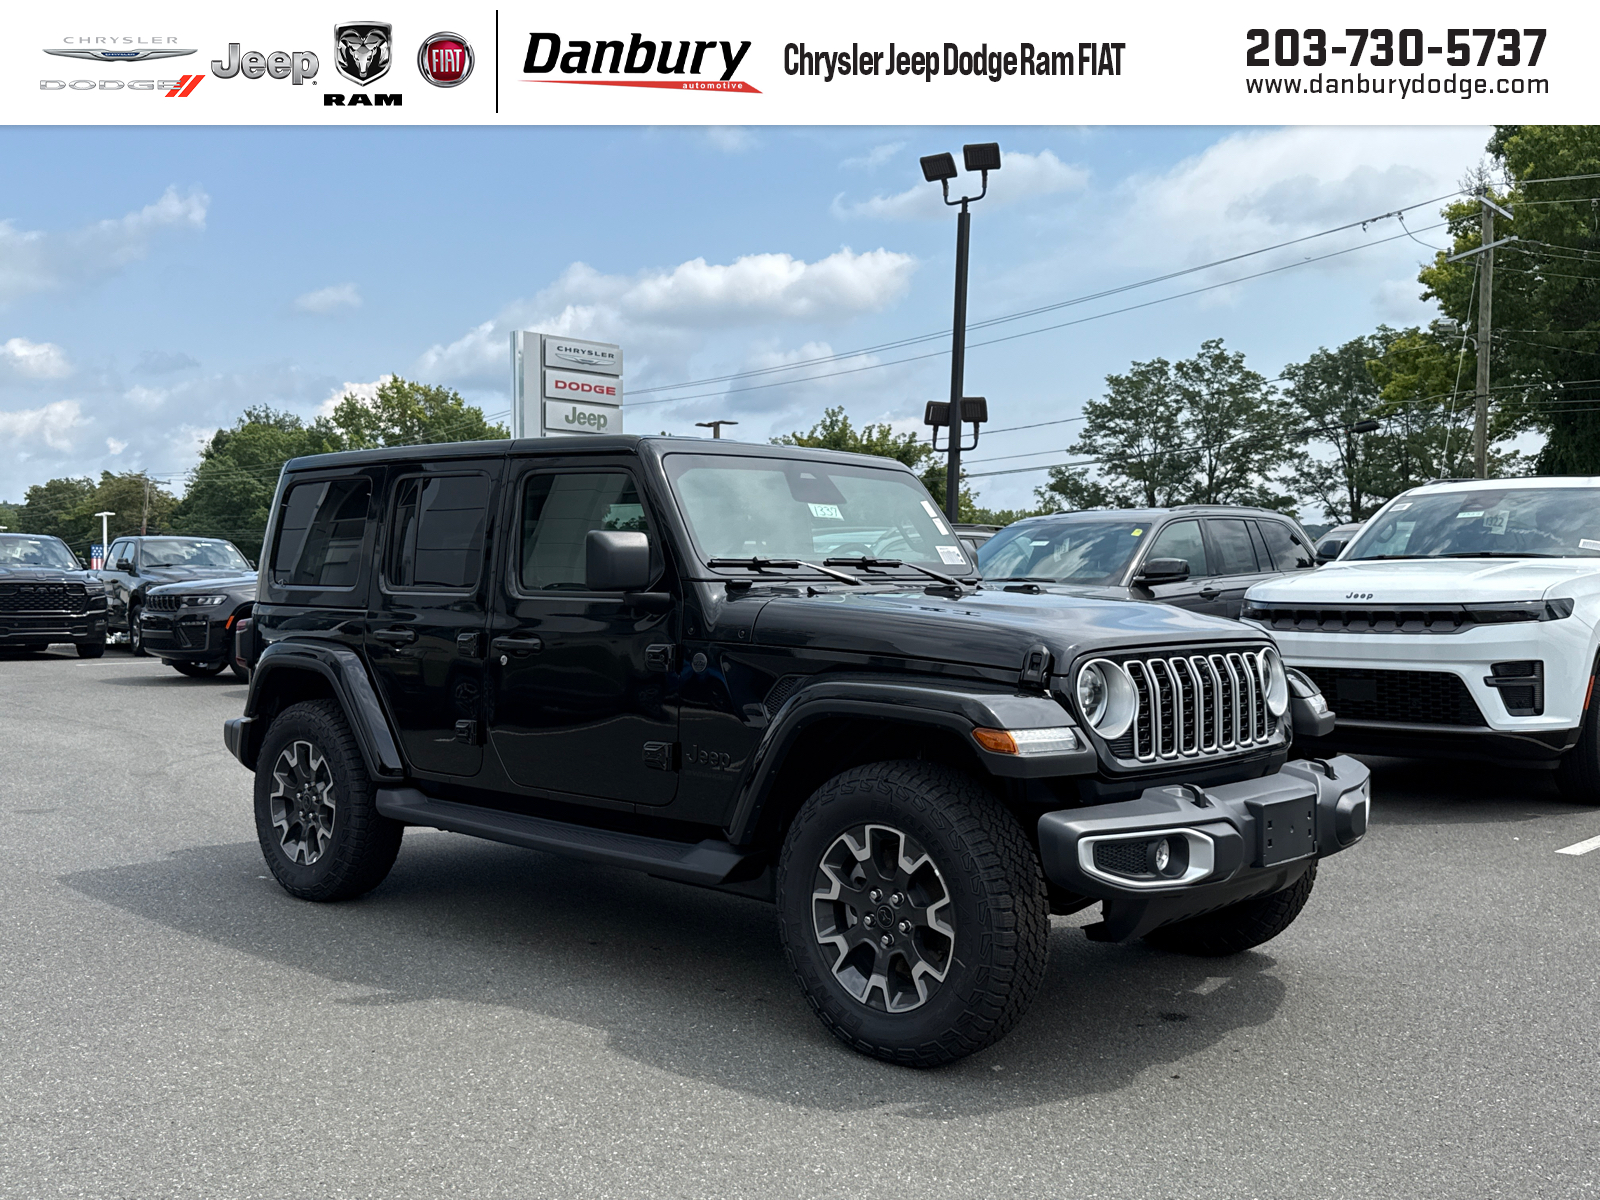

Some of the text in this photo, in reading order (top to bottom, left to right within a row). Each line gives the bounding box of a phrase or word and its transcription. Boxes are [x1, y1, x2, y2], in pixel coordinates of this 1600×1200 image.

[556, 345, 615, 359] CHRYSLER
[554, 379, 616, 396] DODGE
[564, 406, 608, 431] Jeep
[1345, 591, 1374, 601] Jeep
[685, 743, 731, 771] Jeep
